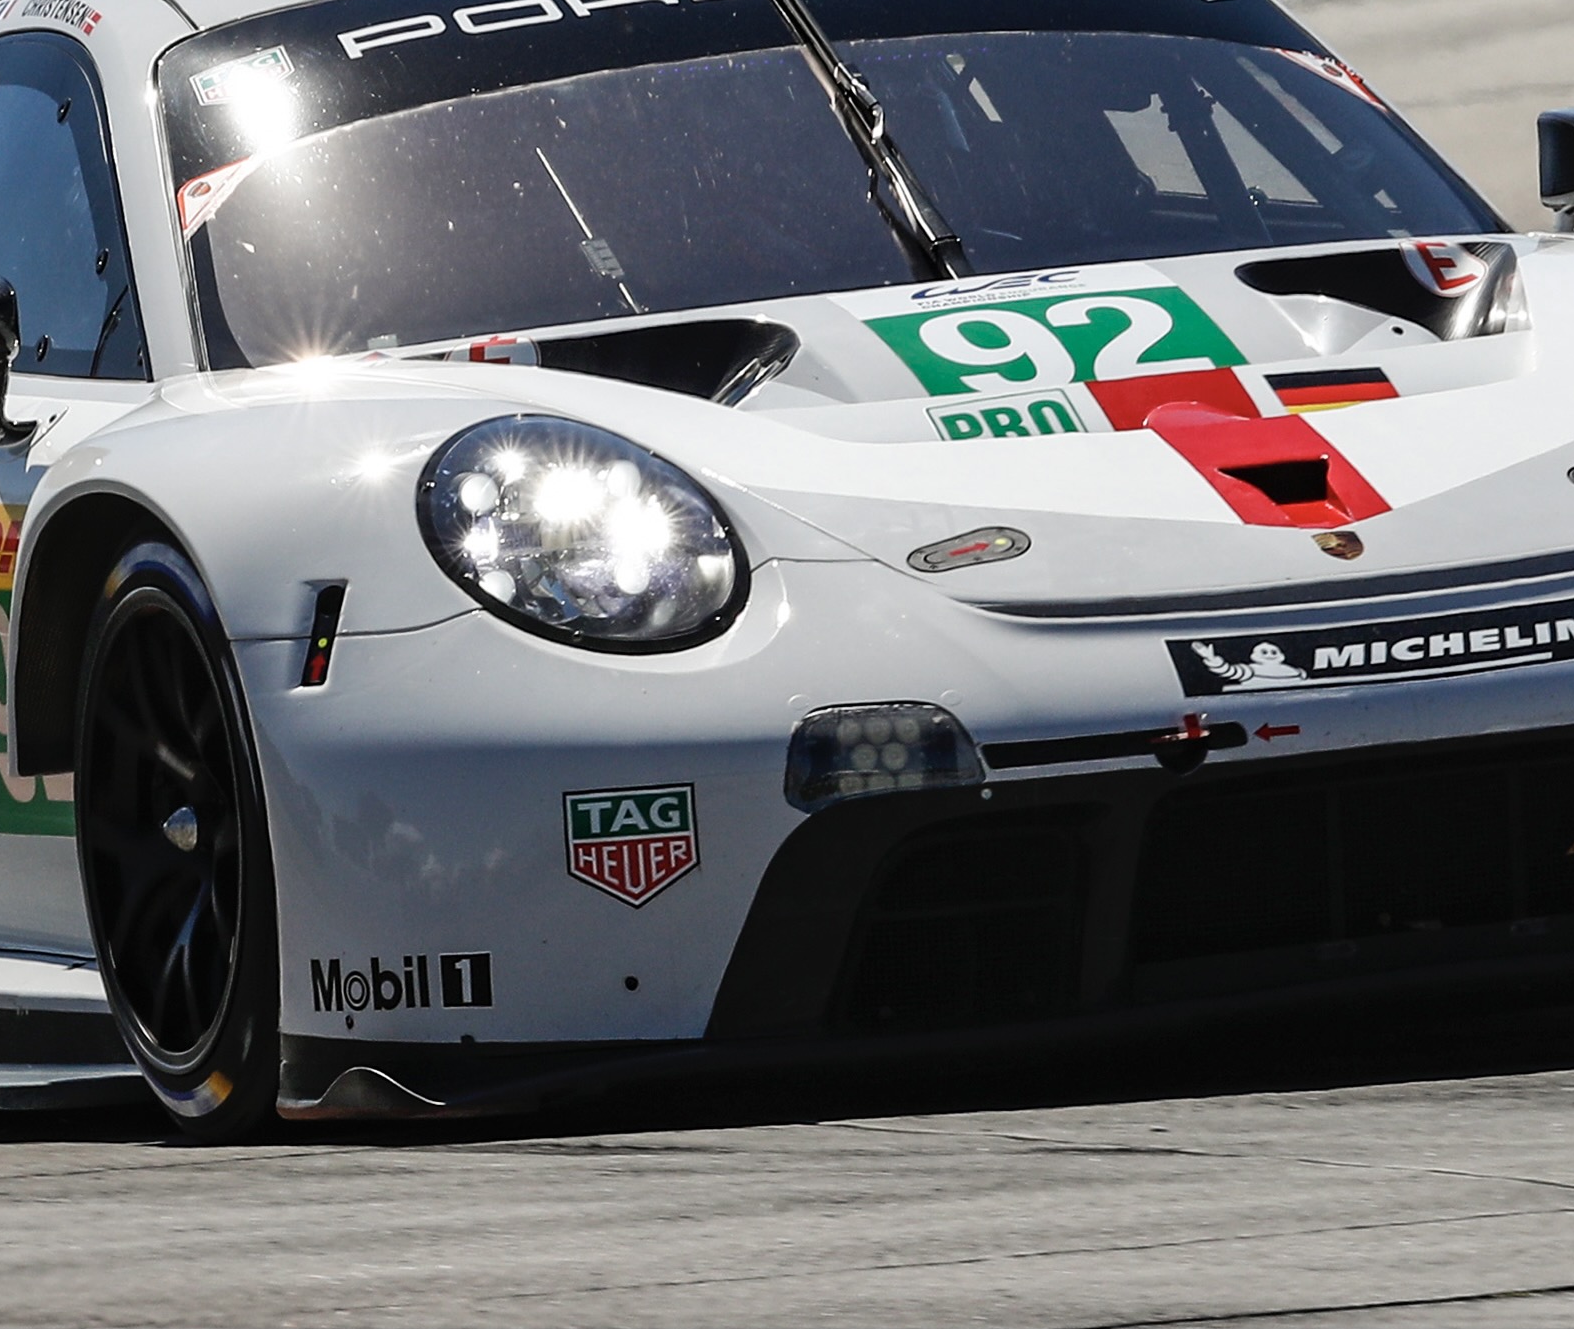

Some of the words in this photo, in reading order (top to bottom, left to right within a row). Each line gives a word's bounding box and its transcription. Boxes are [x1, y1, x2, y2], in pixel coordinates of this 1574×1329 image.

[911, 270, 1081, 300] WEC
[1414, 242, 1479, 291] E
[919, 295, 1217, 393] 92
[577, 796, 681, 834] TAG
[578, 840, 688, 894] HEUER
[310, 954, 431, 1012] Mobil
